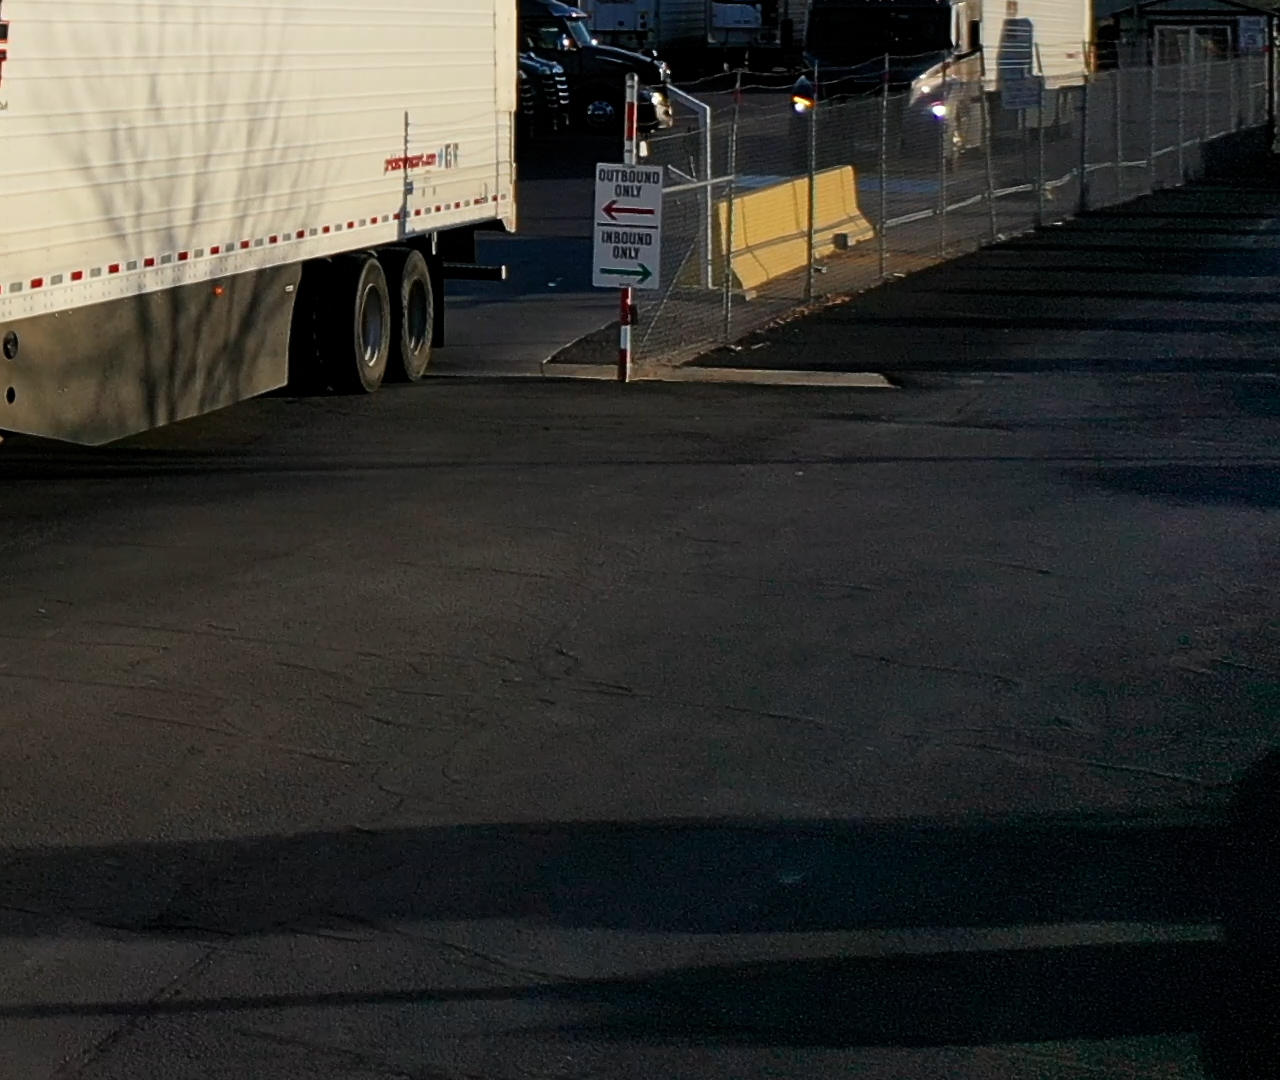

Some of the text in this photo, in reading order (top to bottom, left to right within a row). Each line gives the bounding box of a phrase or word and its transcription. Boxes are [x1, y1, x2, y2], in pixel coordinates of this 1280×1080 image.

[598, 168, 660, 185] OUTBOUND
[614, 184, 642, 198] ONLY
[601, 230, 652, 246] INBOUND
[612, 245, 640, 260] ONLY
